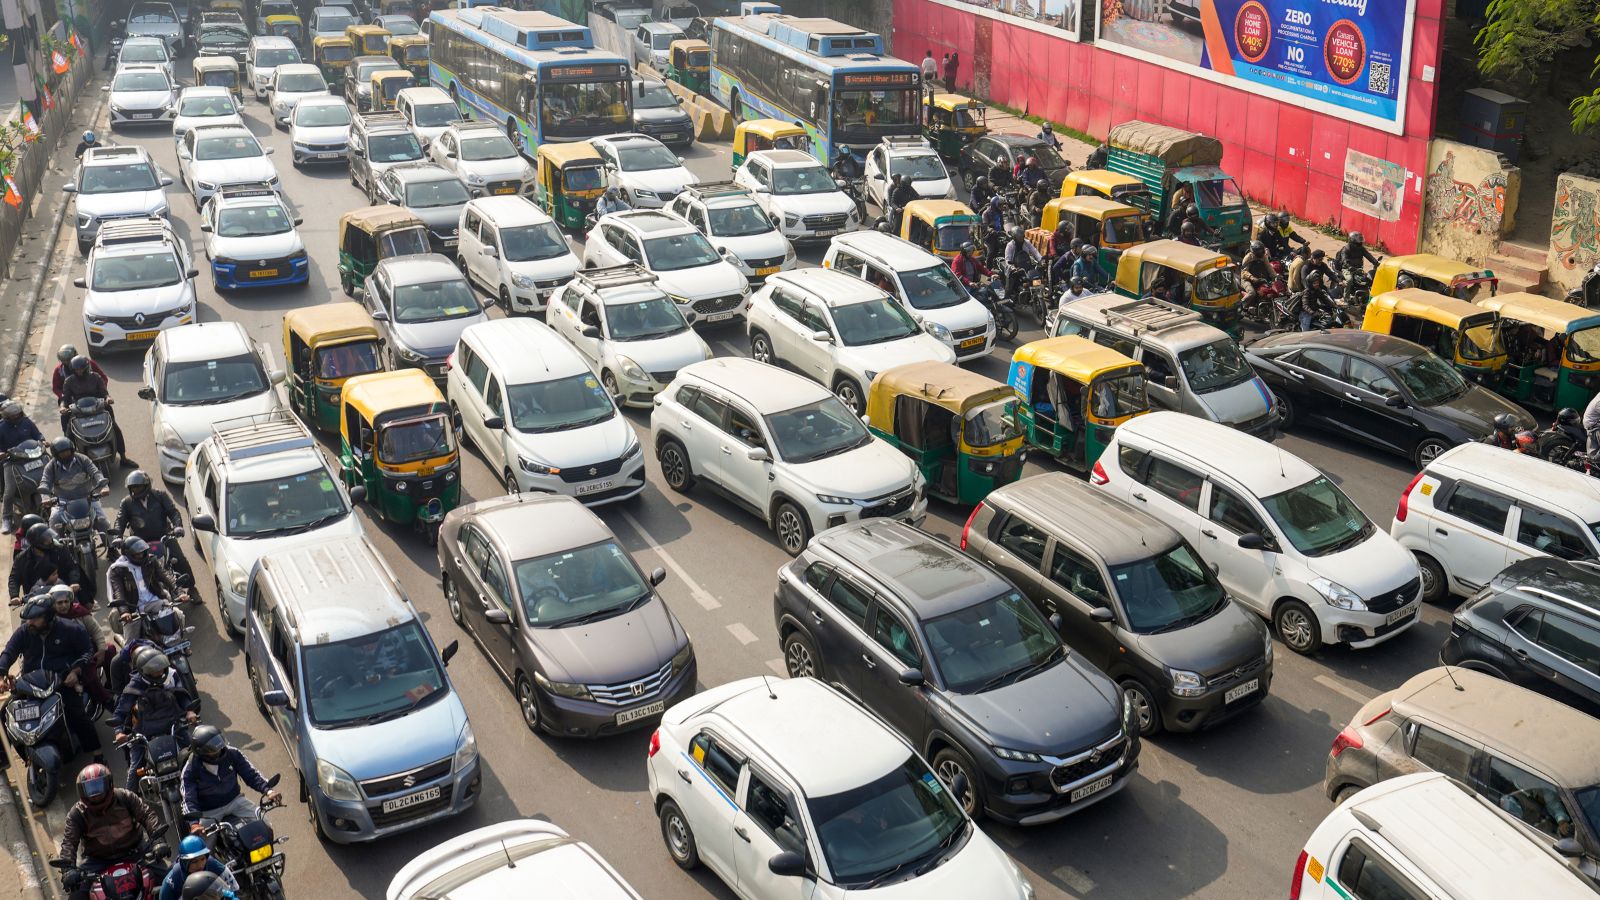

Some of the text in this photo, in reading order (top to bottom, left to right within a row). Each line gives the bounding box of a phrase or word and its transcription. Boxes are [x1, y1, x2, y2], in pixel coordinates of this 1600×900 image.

[1244, 20, 1261, 28] HOME
[1285, 9, 1311, 26] ZERO
[1244, 27, 1260, 36] LOAN
[1336, 30, 1355, 41] Canara
[1242, 34, 1263, 48] 7.40%
[1332, 38, 1358, 50] VEHICLE
[1287, 45, 1304, 63] NO
[1335, 47, 1353, 57] LOAN
[1333, 55, 1355, 69] 7.70%
[620, 703, 664, 722] DL13CC1005
[388, 788, 440, 810] DL2CAN6165
